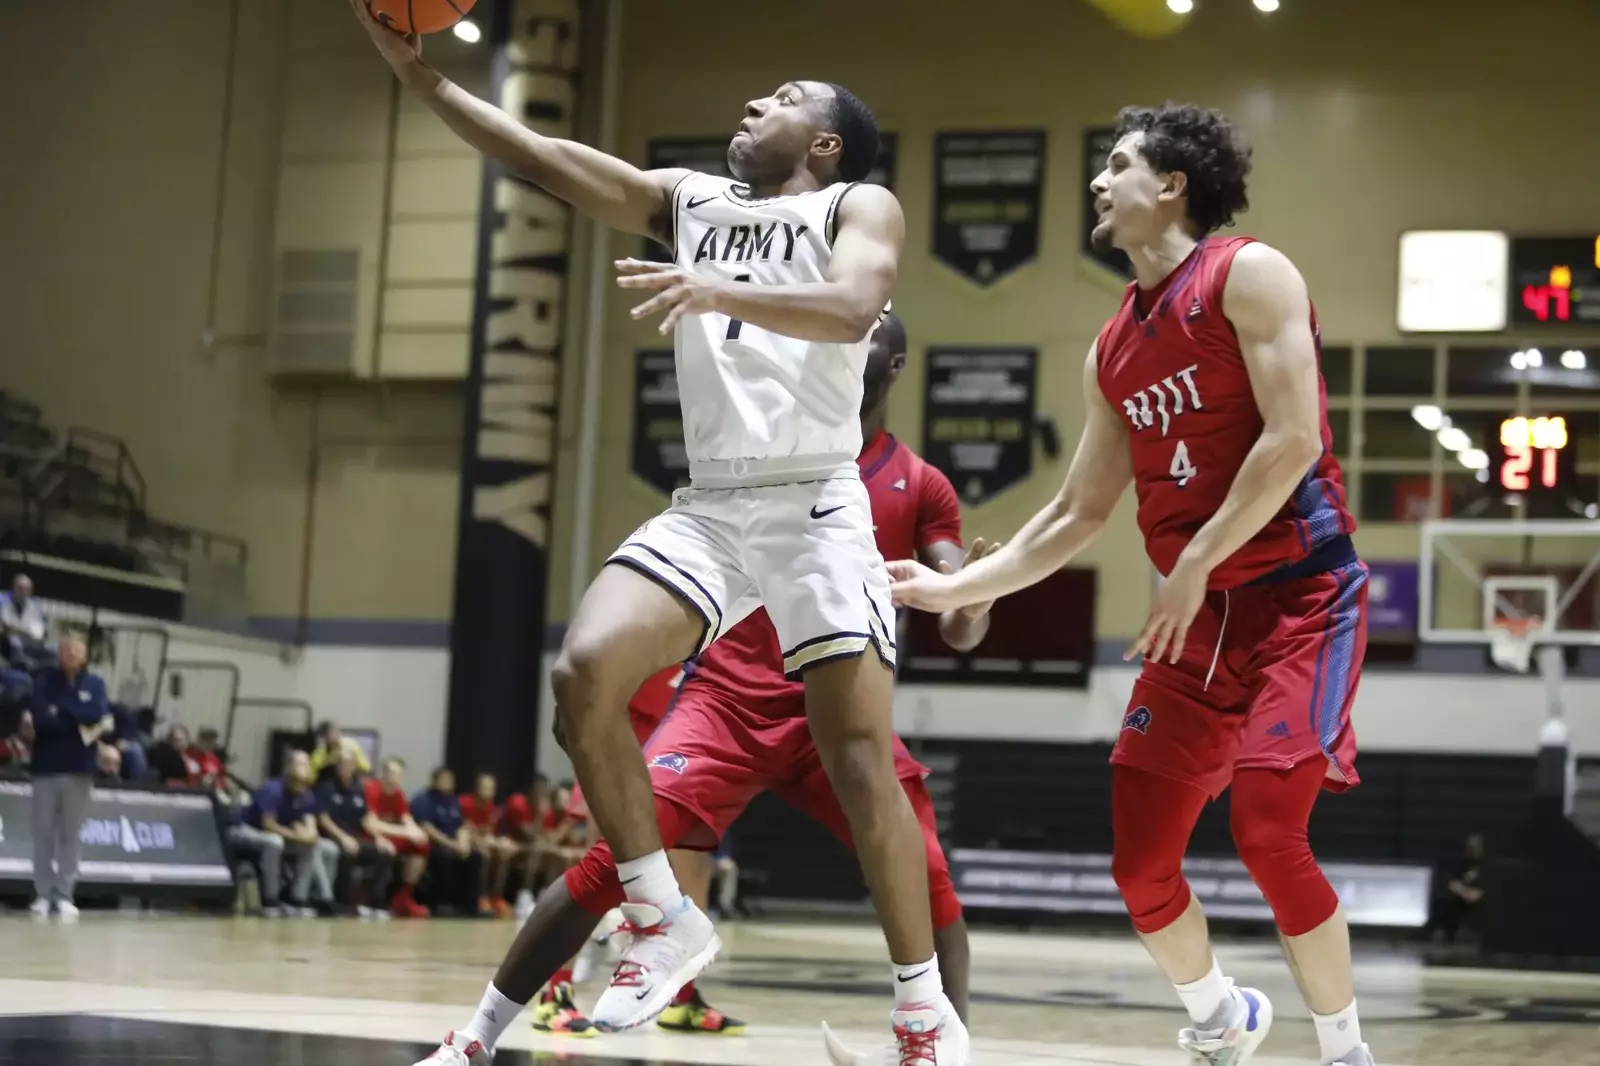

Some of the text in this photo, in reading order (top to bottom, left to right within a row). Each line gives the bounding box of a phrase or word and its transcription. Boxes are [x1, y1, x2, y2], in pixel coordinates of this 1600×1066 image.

[694, 221, 809, 264] ARMY
[473, 177, 570, 550] ARMY
[1121, 363, 1204, 437] NJIT
[1169, 440, 1198, 488] 4
[1502, 446, 1557, 489] 21
